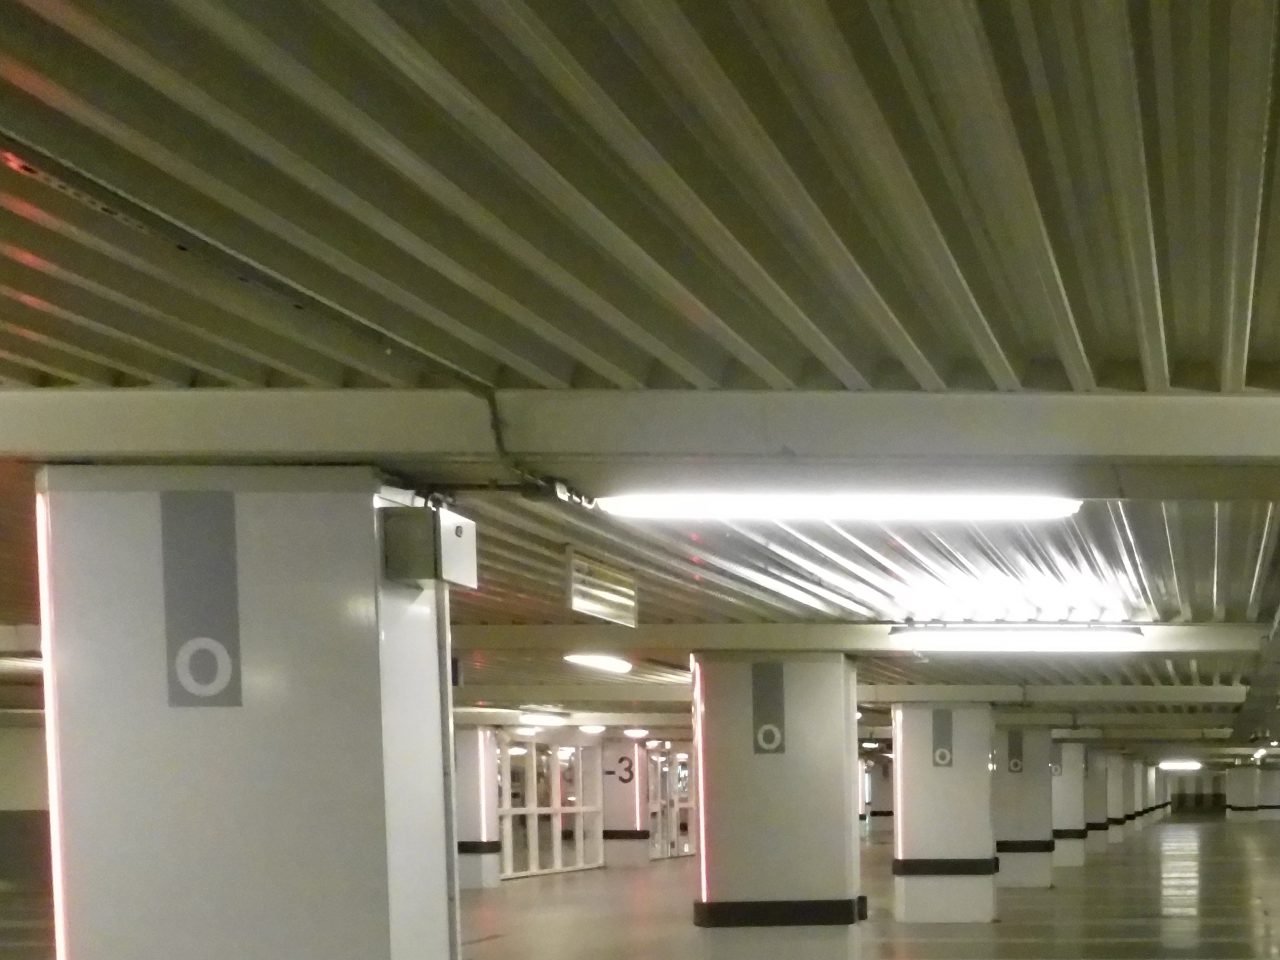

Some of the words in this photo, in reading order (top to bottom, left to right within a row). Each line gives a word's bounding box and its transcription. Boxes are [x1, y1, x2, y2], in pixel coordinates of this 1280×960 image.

[175, 637, 233, 697] O
[757, 724, 782, 750] O
[935, 748, 951, 765] O
[1010, 759, 1022, 771] O
[605, 756, 634, 784] -3
